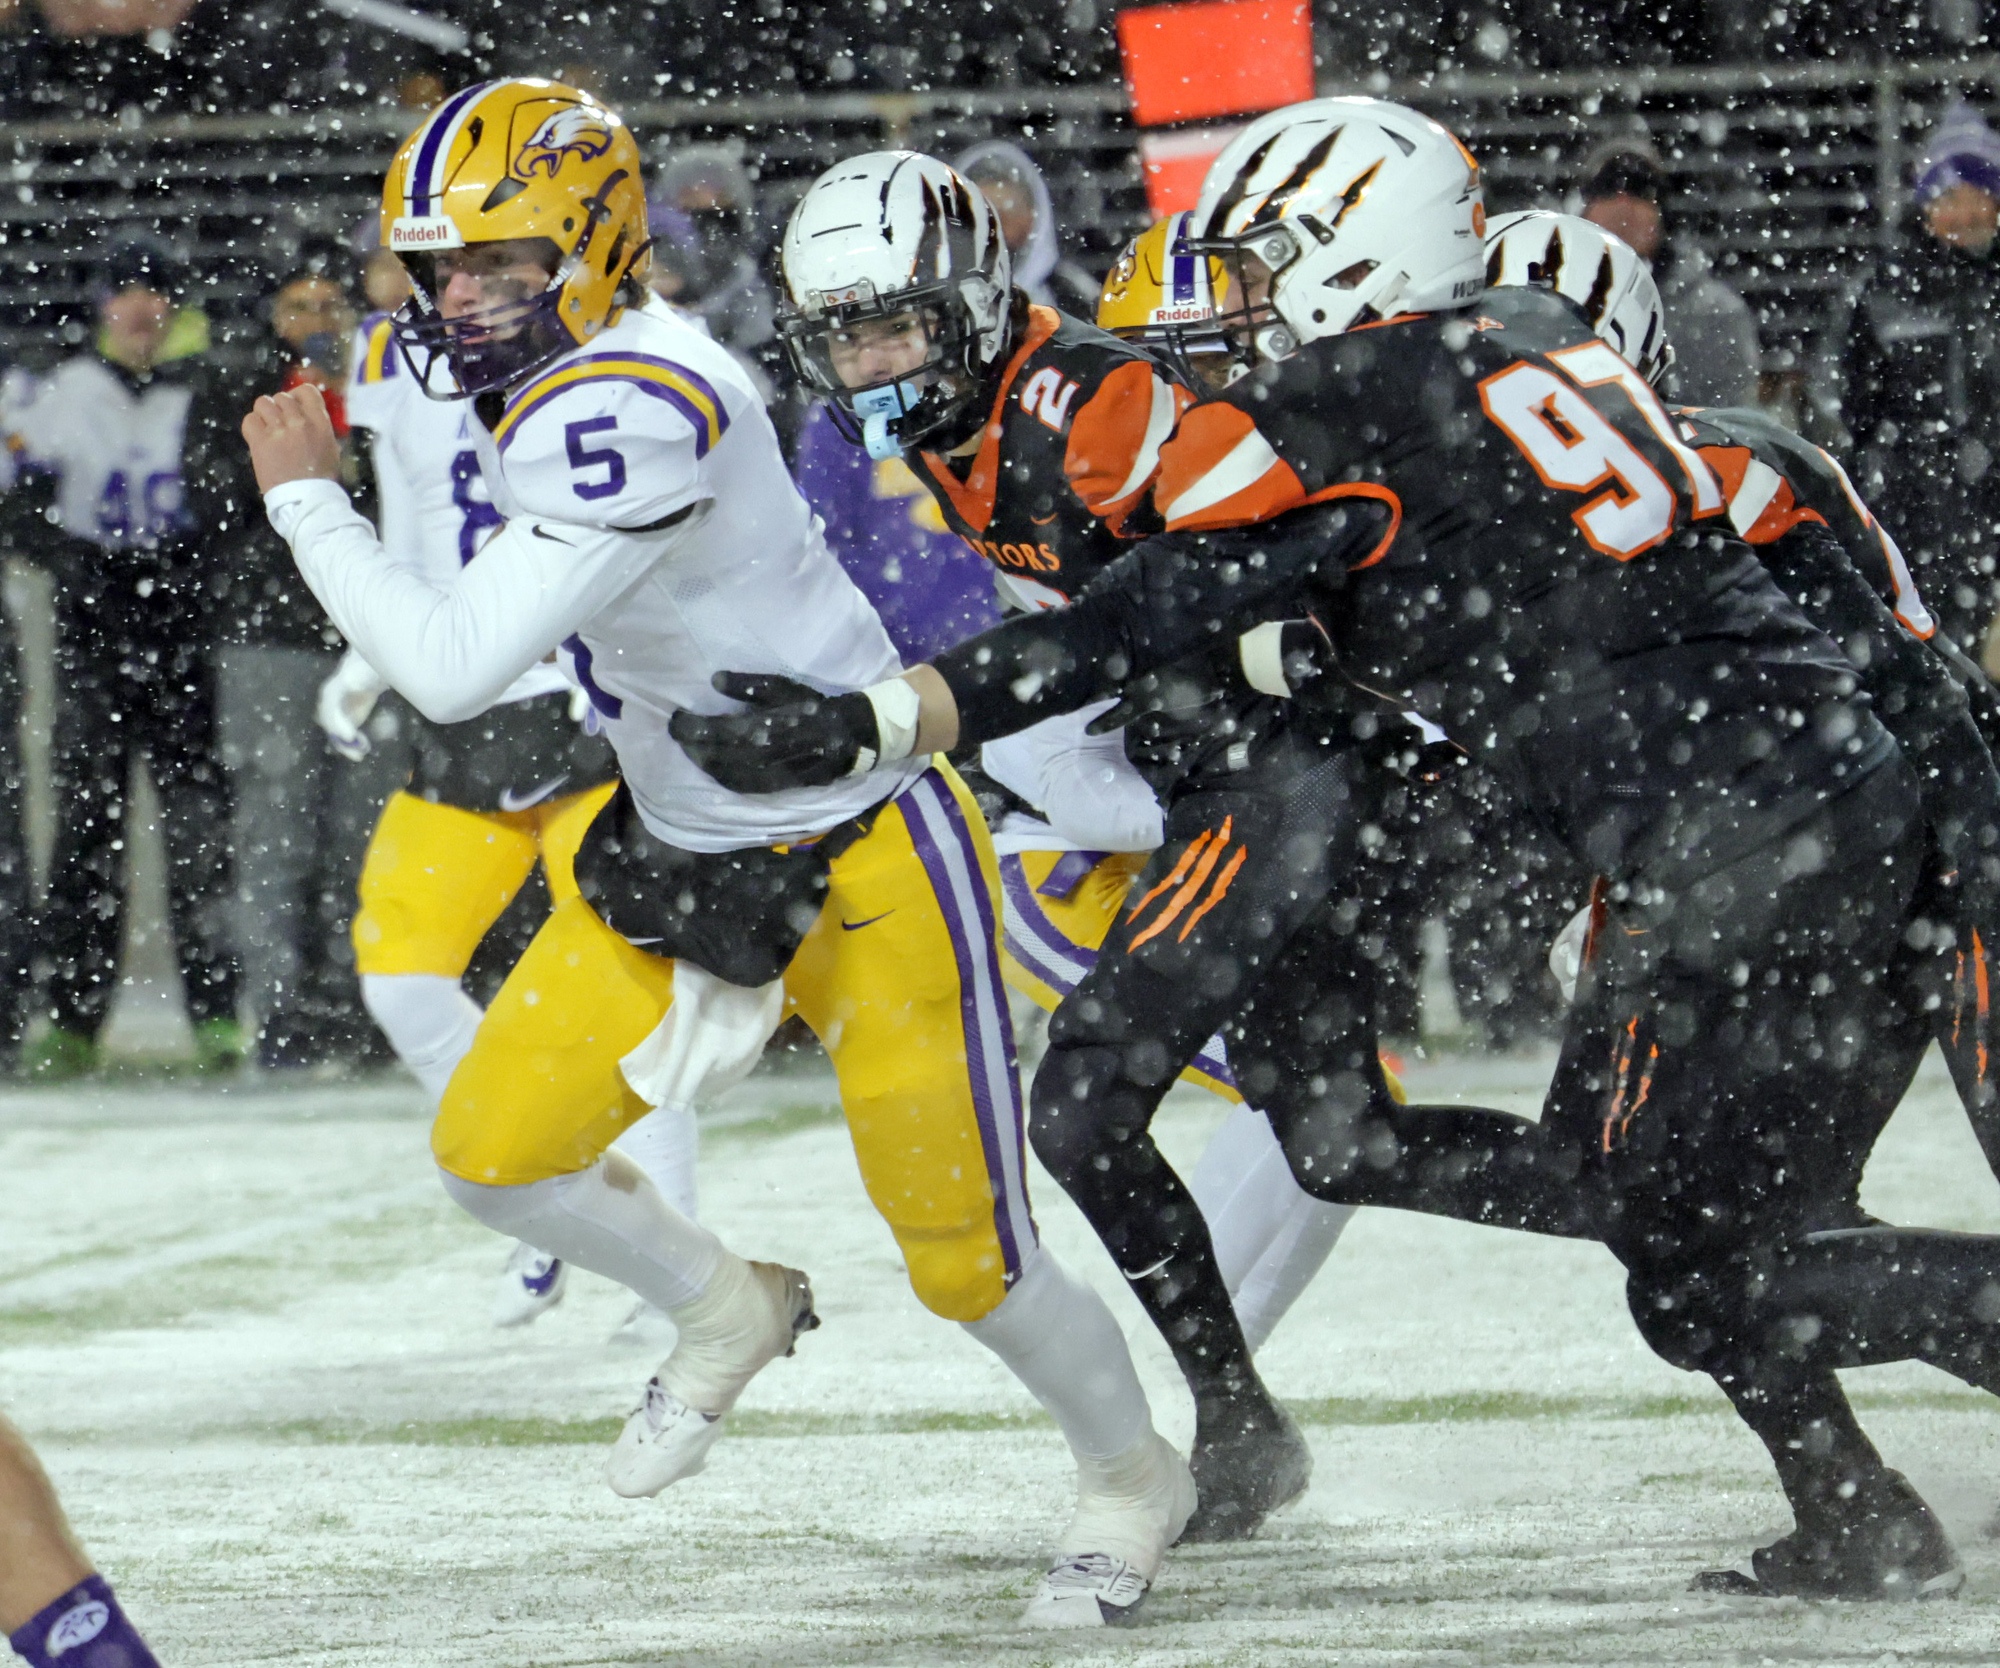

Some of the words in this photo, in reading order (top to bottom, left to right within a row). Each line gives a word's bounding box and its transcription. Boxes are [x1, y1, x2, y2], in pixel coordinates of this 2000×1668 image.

[393, 224, 448, 242] Riddell
[1156, 307, 1212, 322] Riddell
[1020, 365, 1081, 433] 2
[565, 415, 627, 501] 5
[1477, 340, 1725, 562] 97
